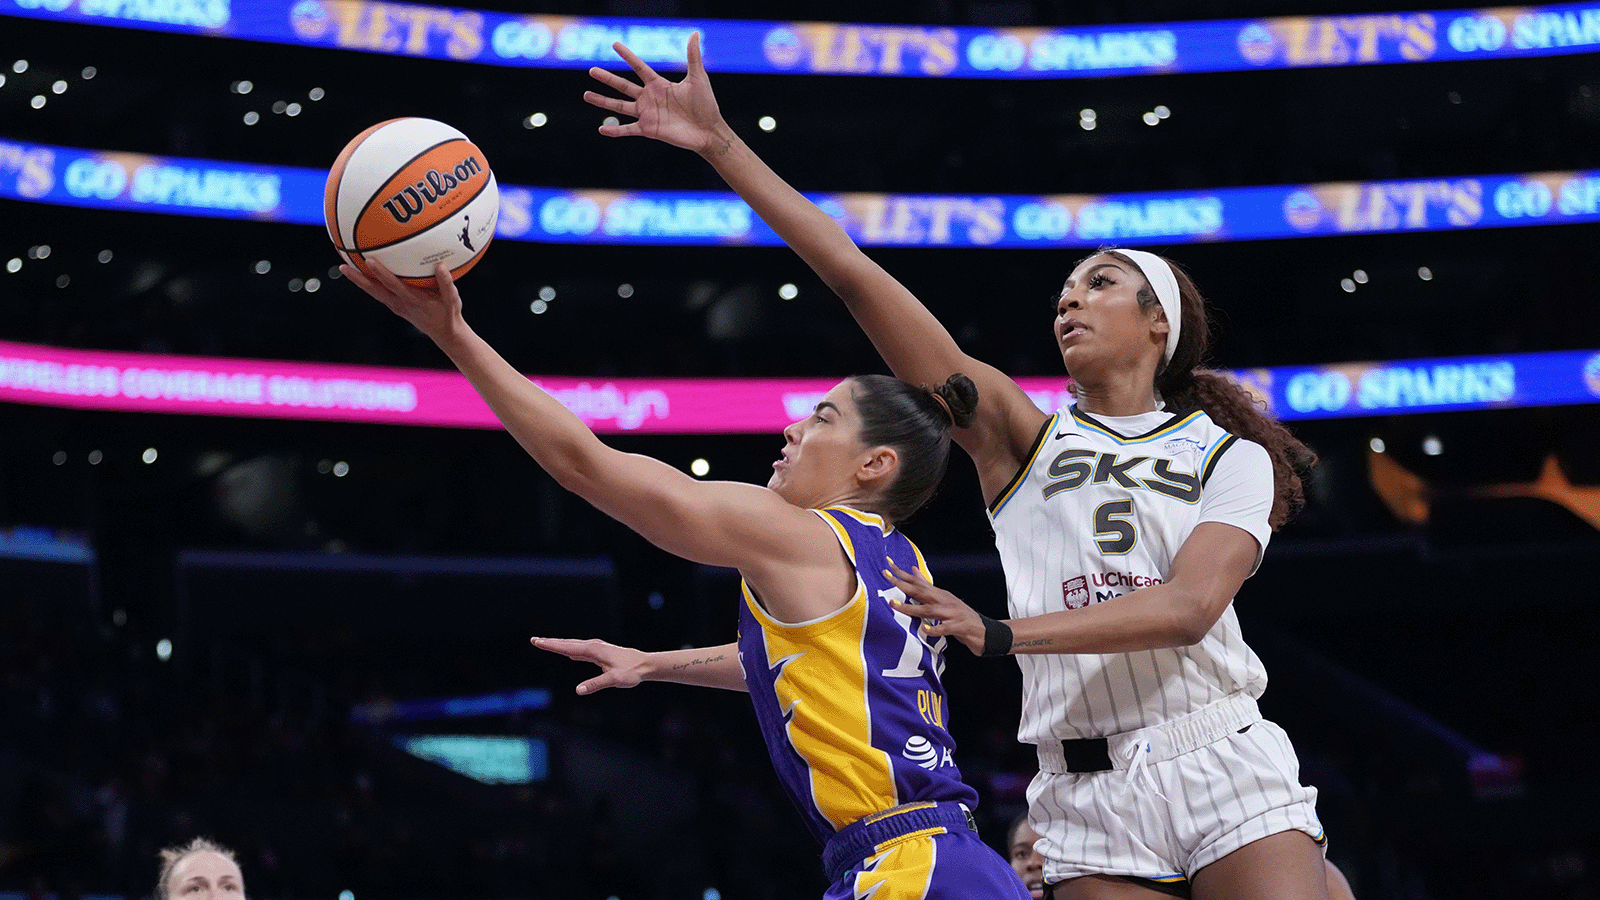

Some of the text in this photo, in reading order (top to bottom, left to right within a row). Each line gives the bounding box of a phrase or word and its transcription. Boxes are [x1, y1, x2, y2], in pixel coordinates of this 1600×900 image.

[492, 21, 553, 59] GO
[967, 34, 1026, 71] GO
[1448, 16, 1505, 52] GO
[65, 159, 126, 200] GO
[382, 155, 483, 224] Wilson
[1494, 179, 1552, 218] GO
[540, 196, 599, 235] GO
[1013, 200, 1072, 239] GO
[268, 374, 418, 413] SOLUTIONS
[1286, 370, 1351, 413] GO
[1358, 361, 1516, 409] SPARKS
[1042, 448, 1202, 504] SKY
[1093, 498, 1138, 556] 5
[1091, 571, 1164, 588] UChica
